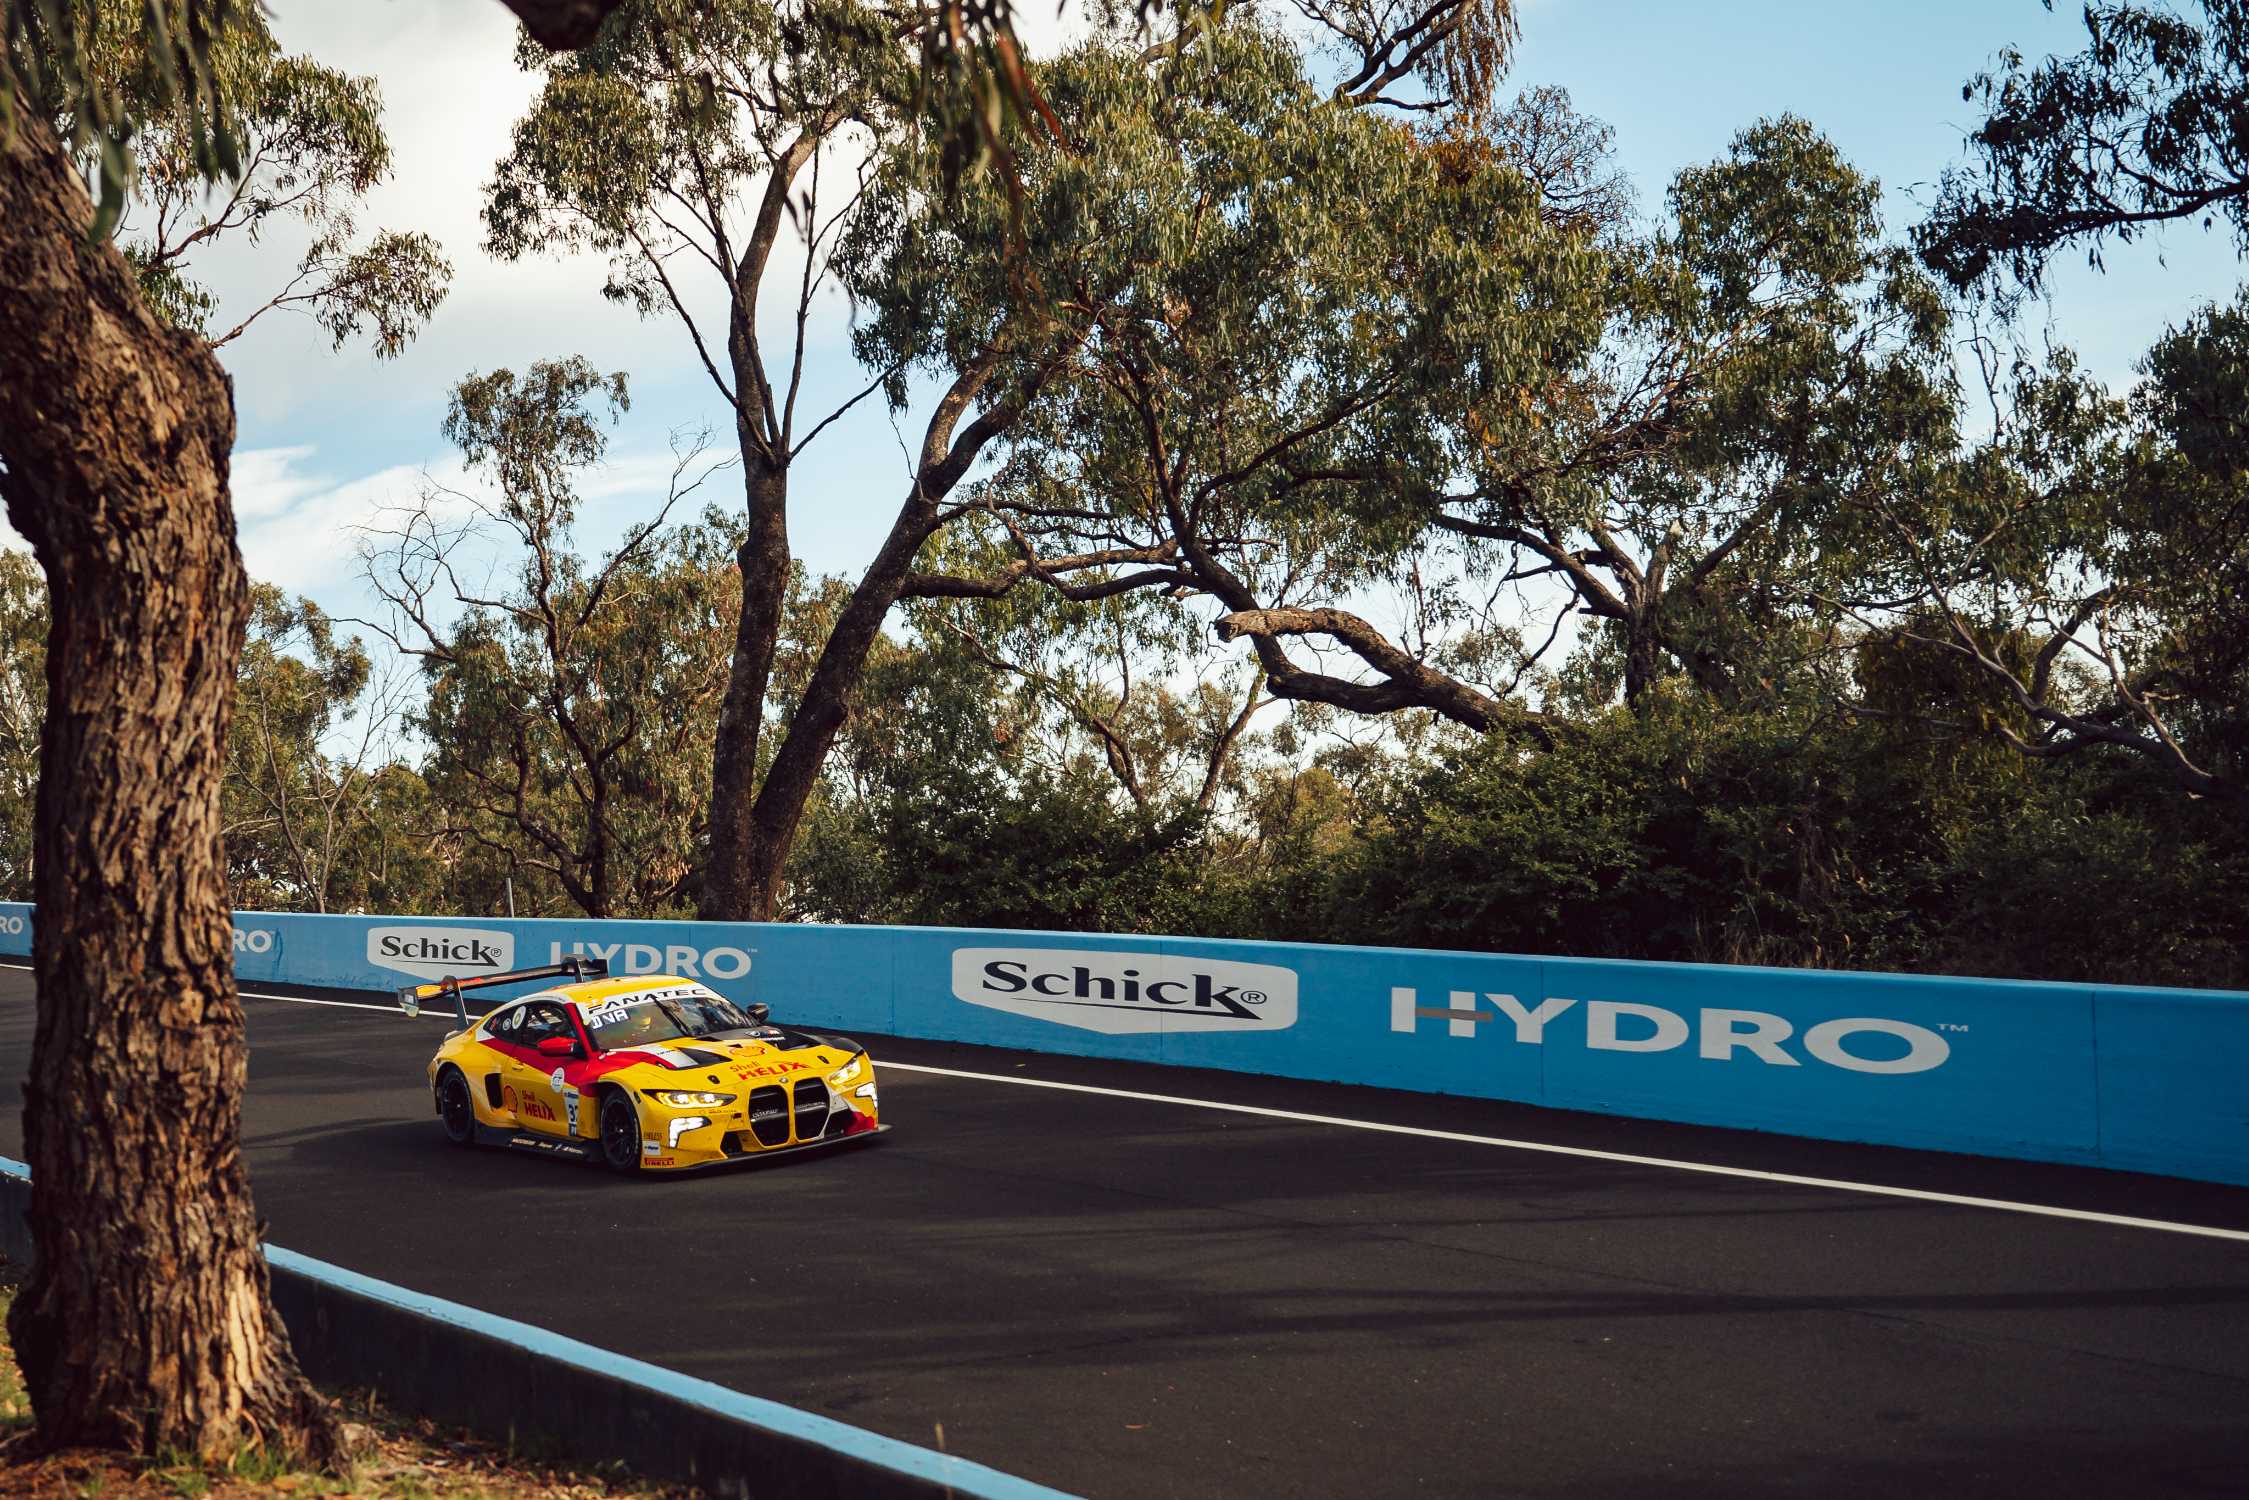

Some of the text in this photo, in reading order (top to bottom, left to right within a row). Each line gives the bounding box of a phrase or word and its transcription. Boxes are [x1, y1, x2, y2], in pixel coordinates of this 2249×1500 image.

[588, 988, 707, 1015] FANATEC
[738, 1061, 809, 1081] HELIX
[523, 1100, 556, 1121] HELIX
